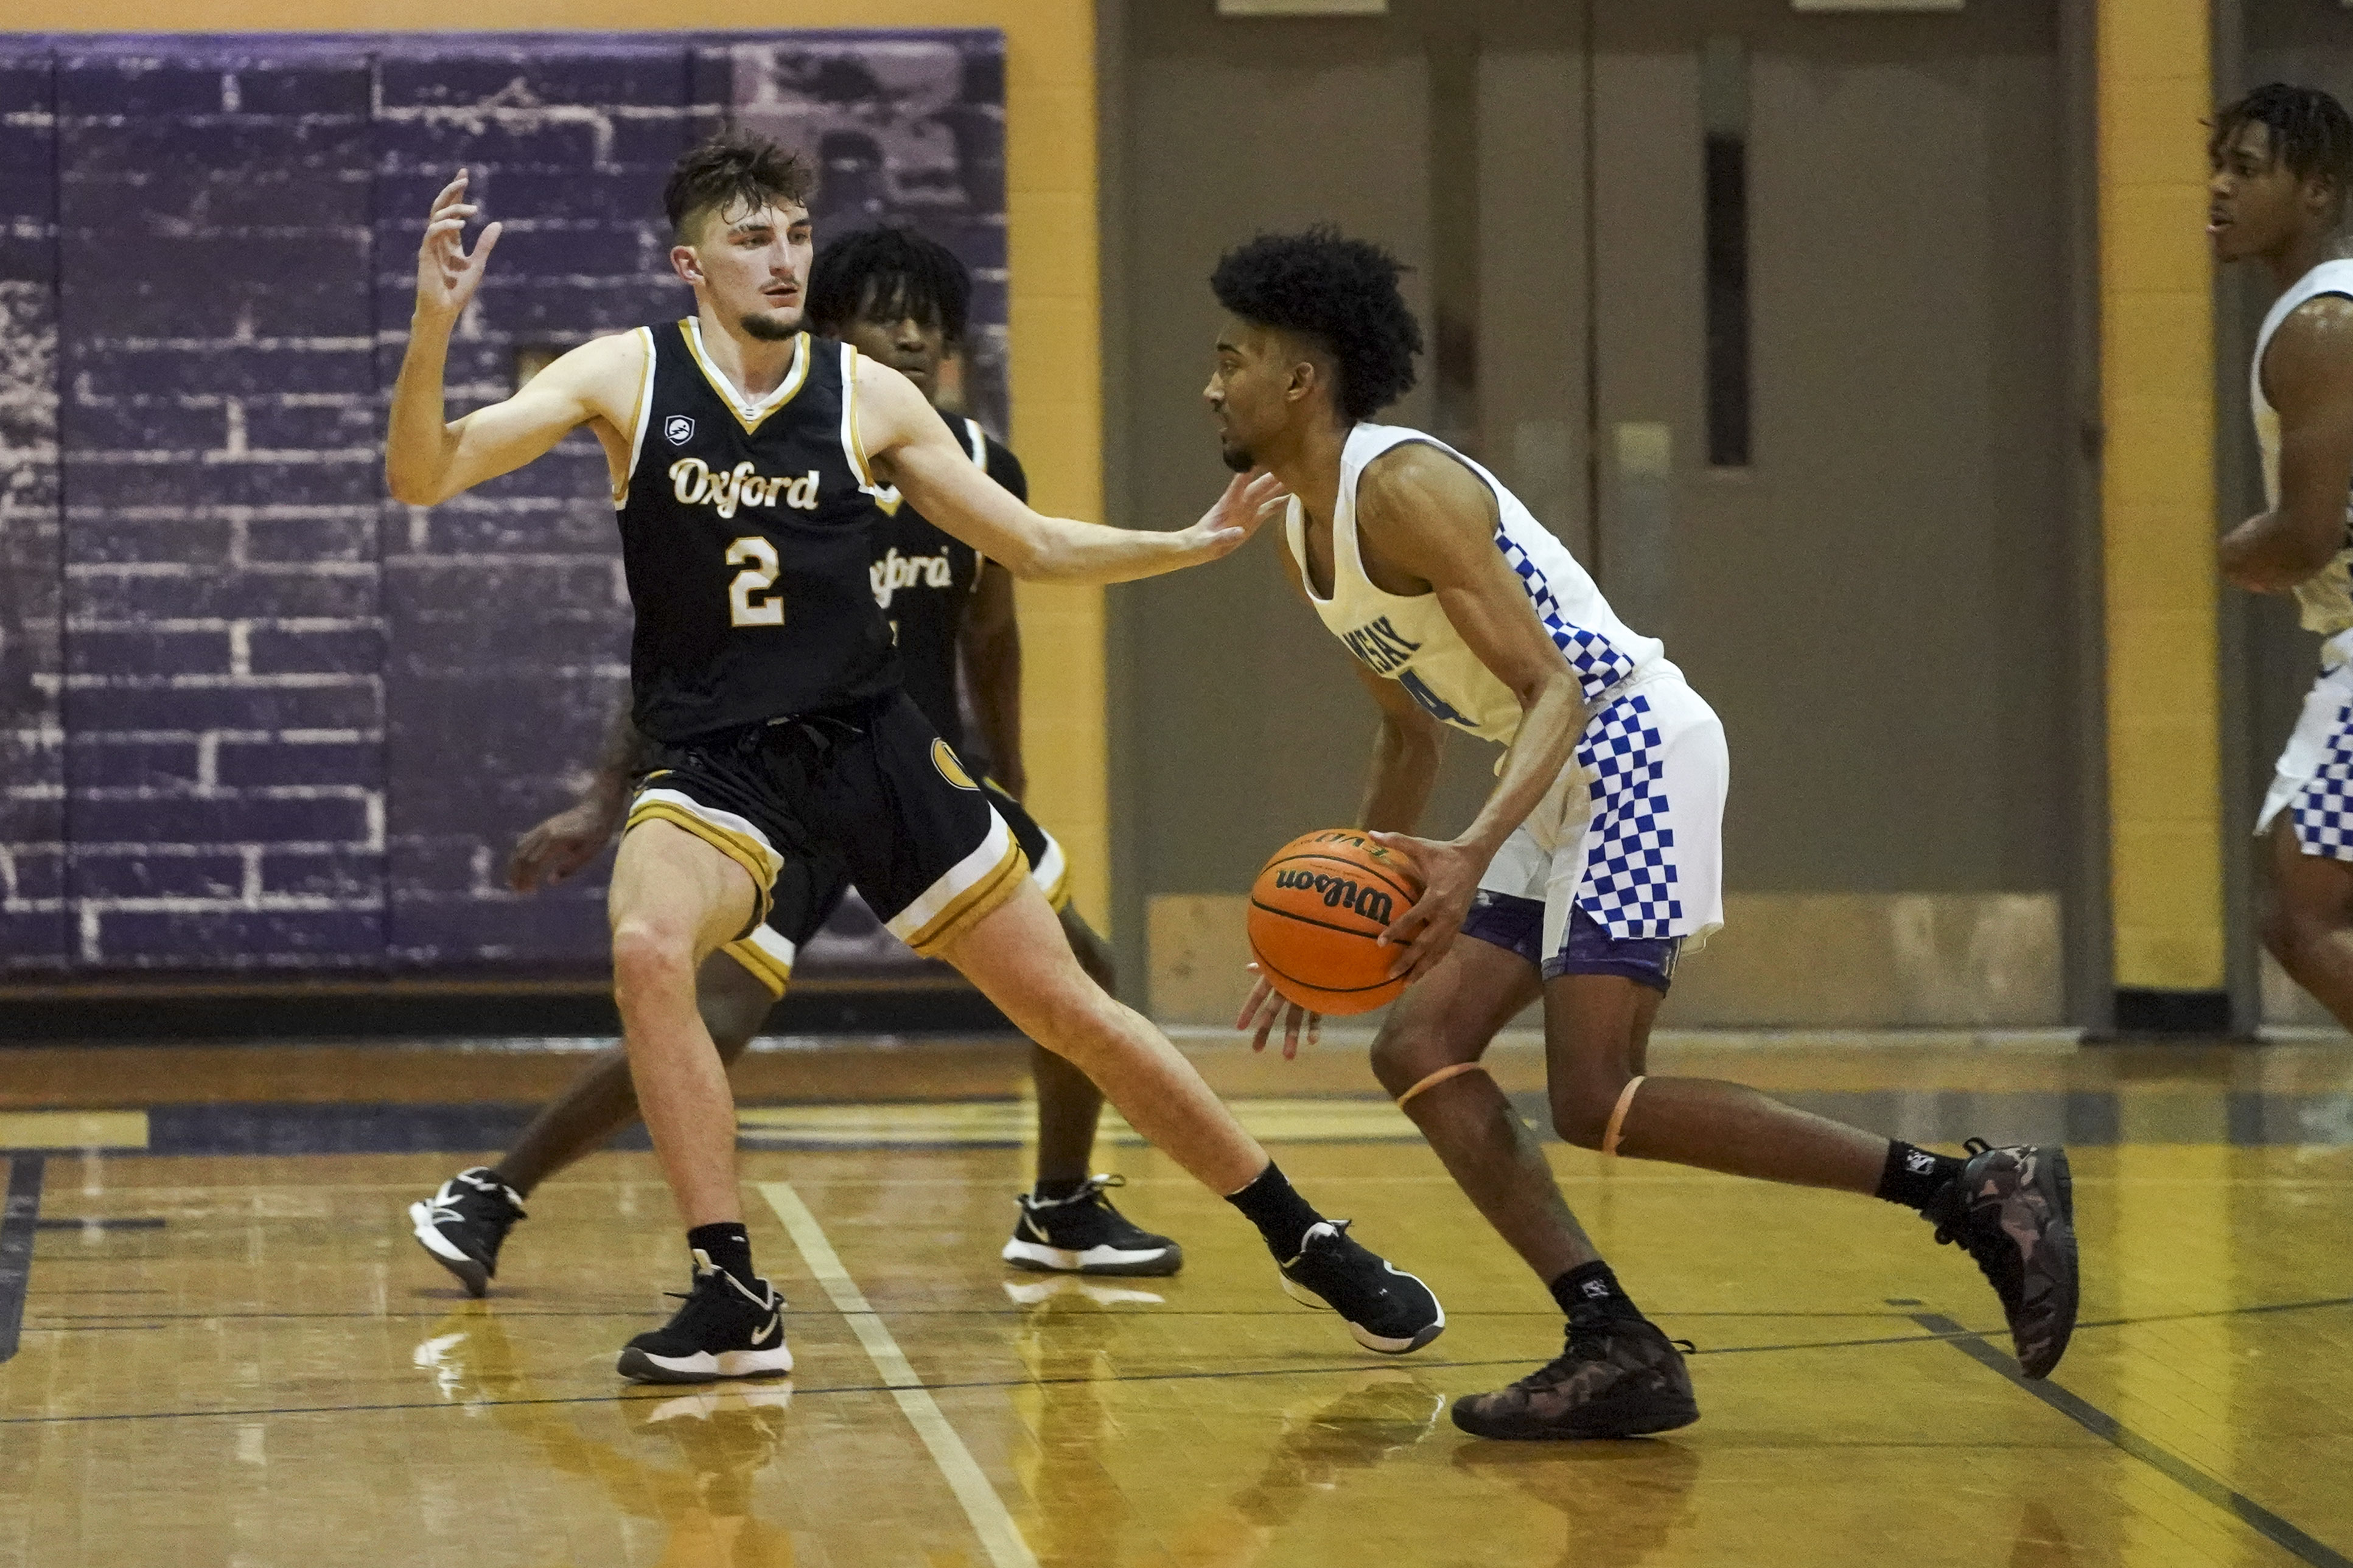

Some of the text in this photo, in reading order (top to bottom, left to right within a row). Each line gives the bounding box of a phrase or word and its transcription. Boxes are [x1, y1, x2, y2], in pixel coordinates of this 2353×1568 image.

[668, 458, 819, 519] Oxford
[725, 536, 785, 627] 2
[869, 545, 952, 609] xford
[1276, 869, 1393, 927] Wilson
